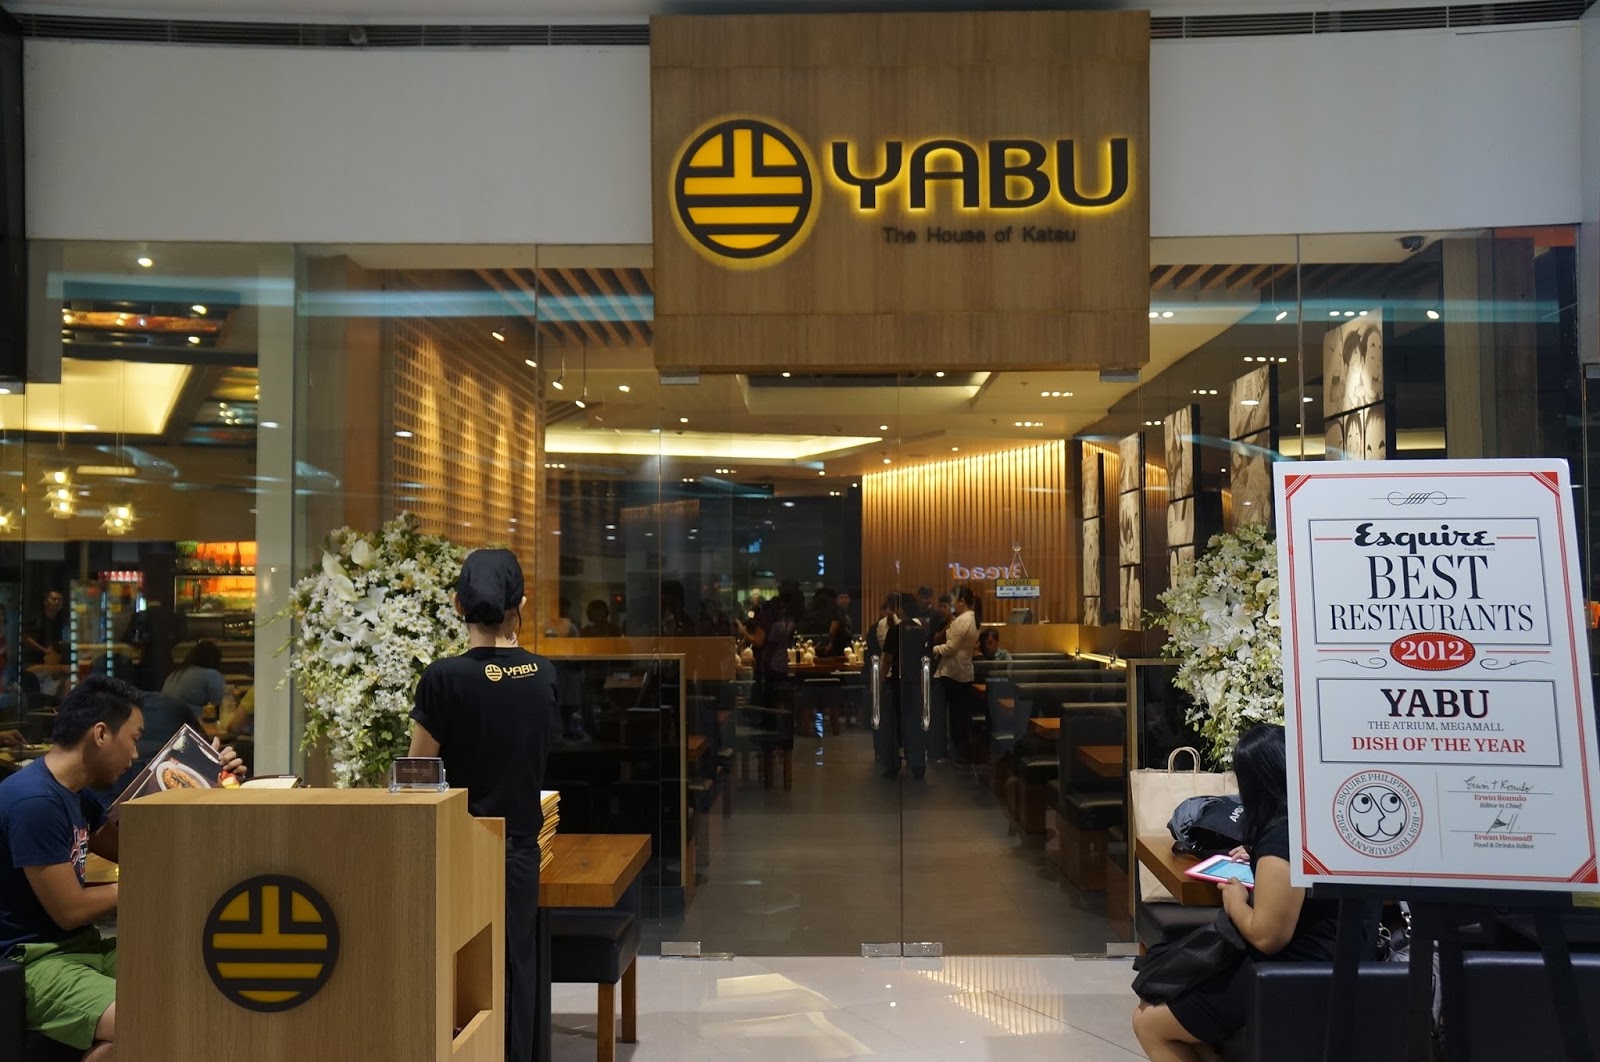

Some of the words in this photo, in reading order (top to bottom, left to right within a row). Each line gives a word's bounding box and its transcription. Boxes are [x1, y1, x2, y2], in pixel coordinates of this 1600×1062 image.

[832, 138, 1128, 208] YABU
[882, 226, 917, 243] The
[927, 226, 986, 243] House
[994, 226, 1013, 243] of
[1023, 226, 1076, 243] Katsu
[1354, 522, 1496, 554] Esquire
[1365, 555, 1489, 600] BEST
[1328, 604, 1534, 632] RESTAURANTS
[1400, 640, 1465, 661] 2012
[502, 662, 538, 676] YABU
[1380, 688, 1490, 719] YABU
[1367, 721, 1391, 730] THE
[1392, 721, 1439, 731] ATRIUM,
[1440, 722, 1505, 732] MEGAMALL
[1351, 736, 1399, 751] DISH
[1402, 737, 1427, 751] OF
[1431, 737, 1471, 752] THE
[1474, 738, 1526, 753] YEAR
[1337, 774, 1367, 806] ESQUIRE
[1368, 773, 1418, 808] PHILIPPINES
[1336, 814, 1349, 834] 2012
[1409, 815, 1420, 840] BEST
[1345, 832, 1410, 855] RESTAURANTS
